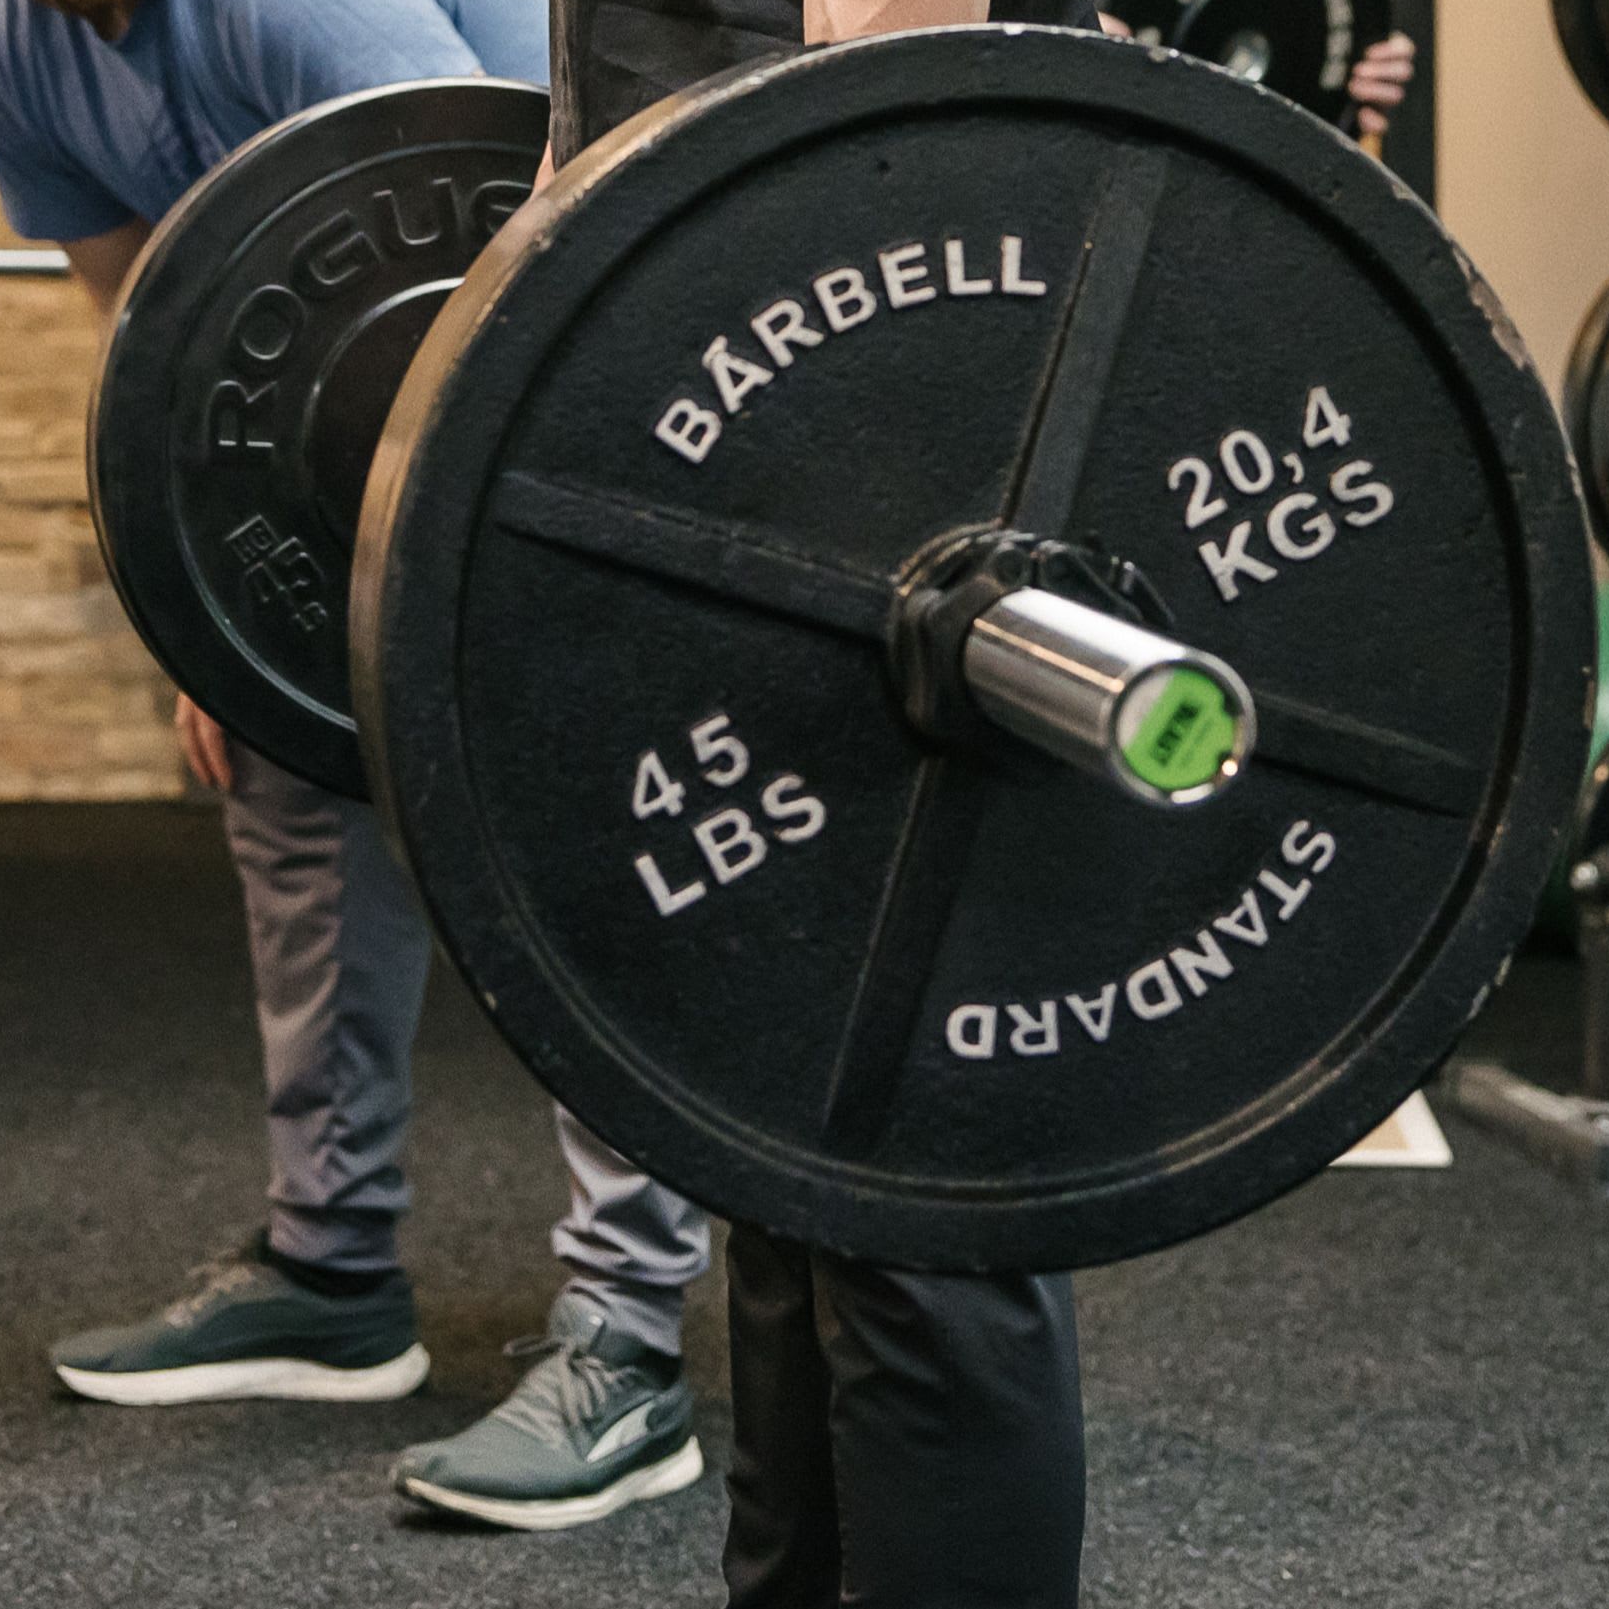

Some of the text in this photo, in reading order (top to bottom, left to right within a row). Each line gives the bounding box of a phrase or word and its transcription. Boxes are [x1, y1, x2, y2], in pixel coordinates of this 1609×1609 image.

[1167, 385, 1352, 530] 20,4
[1197, 459, 1395, 602] KGS
[632, 714, 749, 819] 45
[634, 773, 826, 916] LBS
[945, 819, 1337, 1059] STANDARD
